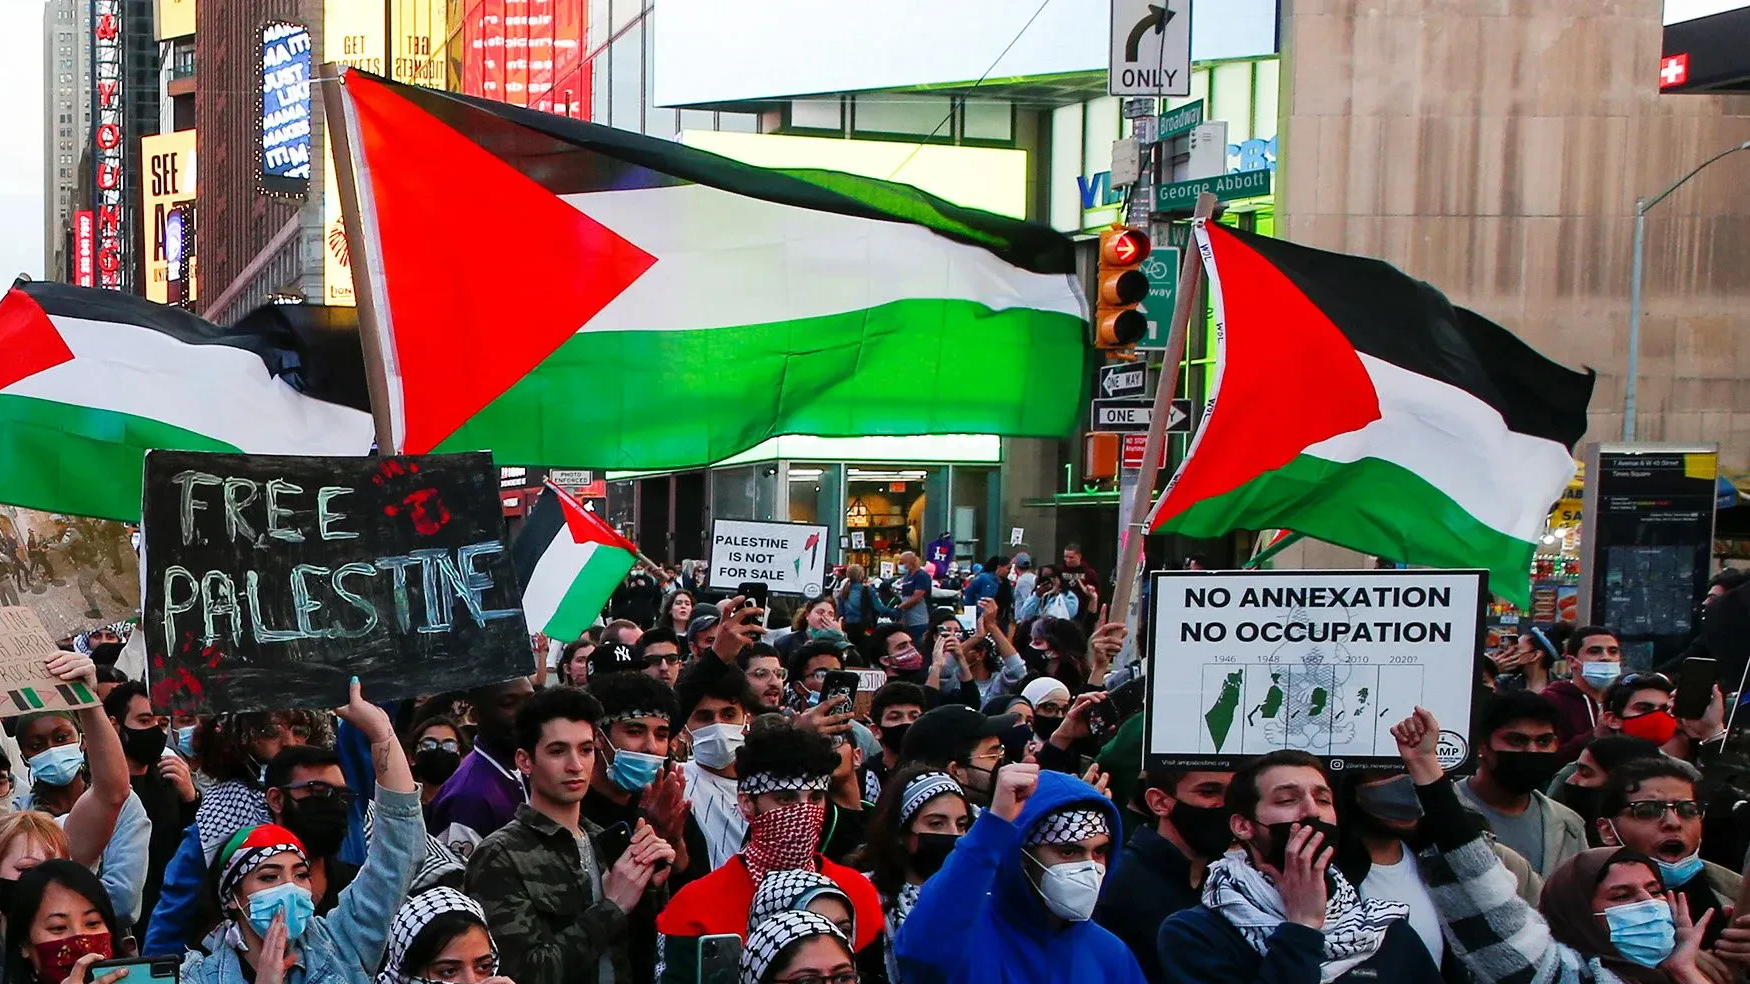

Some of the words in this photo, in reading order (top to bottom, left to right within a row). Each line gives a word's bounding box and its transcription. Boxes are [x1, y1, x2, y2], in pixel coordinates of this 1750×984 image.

[344, 36, 366, 54] GET
[1122, 69, 1178, 88] ONLY
[1160, 107, 1201, 135] Broadway
[151, 152, 179, 197] SEE
[1160, 181, 1210, 199] George
[1215, 173, 1265, 193] Abbott
[1107, 373, 1120, 390] ONE
[1125, 370, 1141, 387] WAY
[1107, 410, 1135, 423] ONE
[172, 469, 360, 546] FREE
[715, 535, 789, 550] PALESTINE
[728, 551, 742, 562] IS
[745, 552, 775, 564] NOT
[719, 567, 747, 578] FOR
[750, 569, 784, 581] SALE
[162, 540, 522, 657] PALESTINE
[1184, 587, 1231, 608] NO
[1238, 586, 1451, 608] ANNEXATION
[1180, 622, 1227, 643] NO
[1235, 621, 1452, 643] OCCUPATION
[1214, 655, 1237, 663] 1946
[1258, 655, 1280, 663] 1948
[1389, 655, 1418, 663] 2020?
